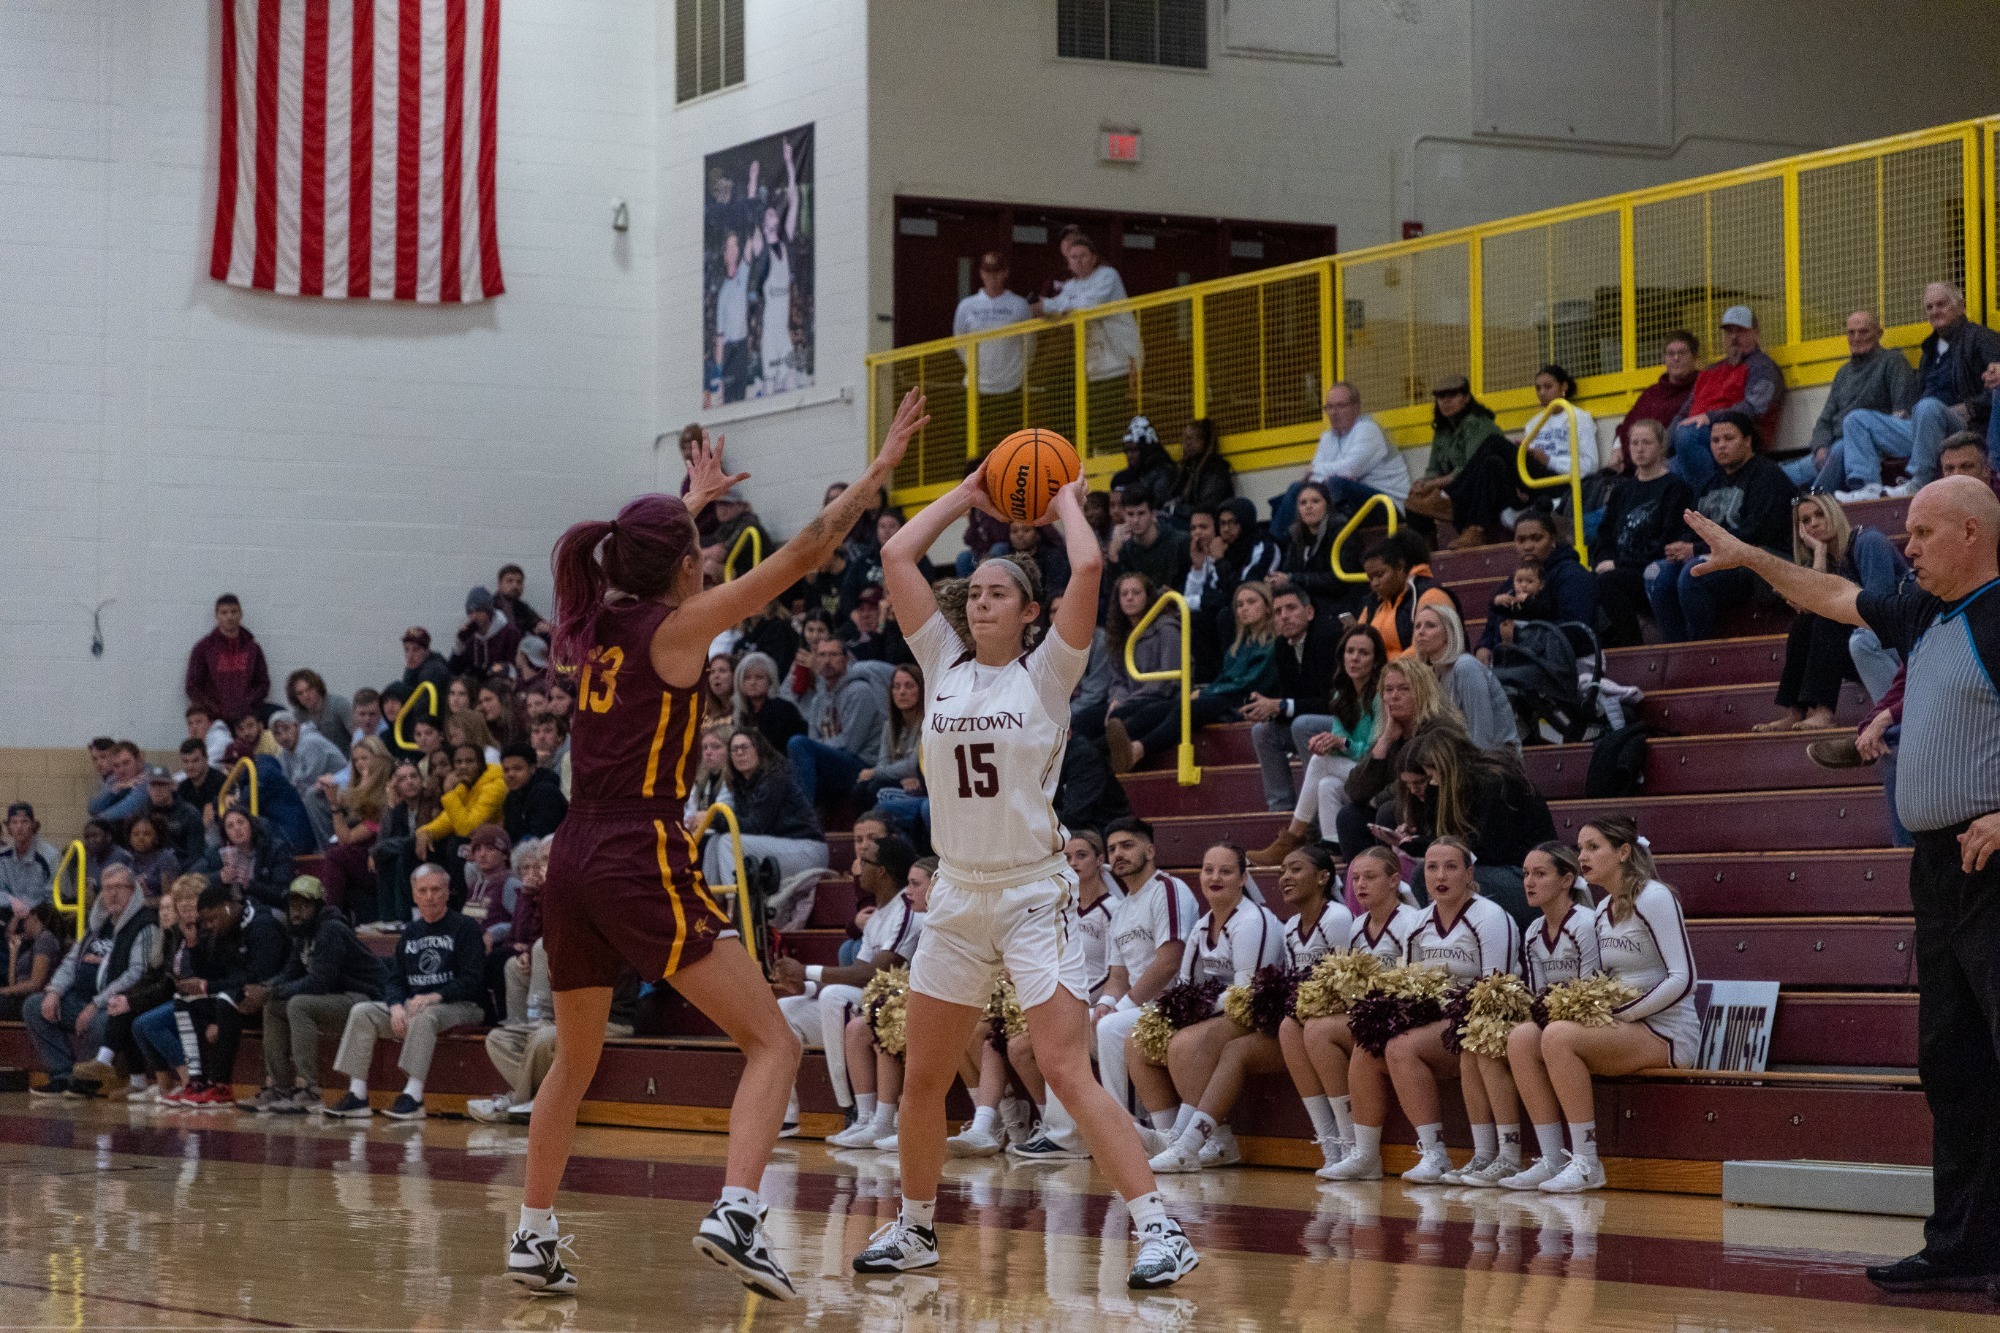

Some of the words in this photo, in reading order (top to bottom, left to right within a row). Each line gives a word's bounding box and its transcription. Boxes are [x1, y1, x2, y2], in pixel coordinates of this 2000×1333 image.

[1009, 464, 1031, 521] Wilson
[578, 645, 625, 714] 13
[930, 711, 1027, 734] KUTZTOWN
[954, 742, 1000, 798] 15
